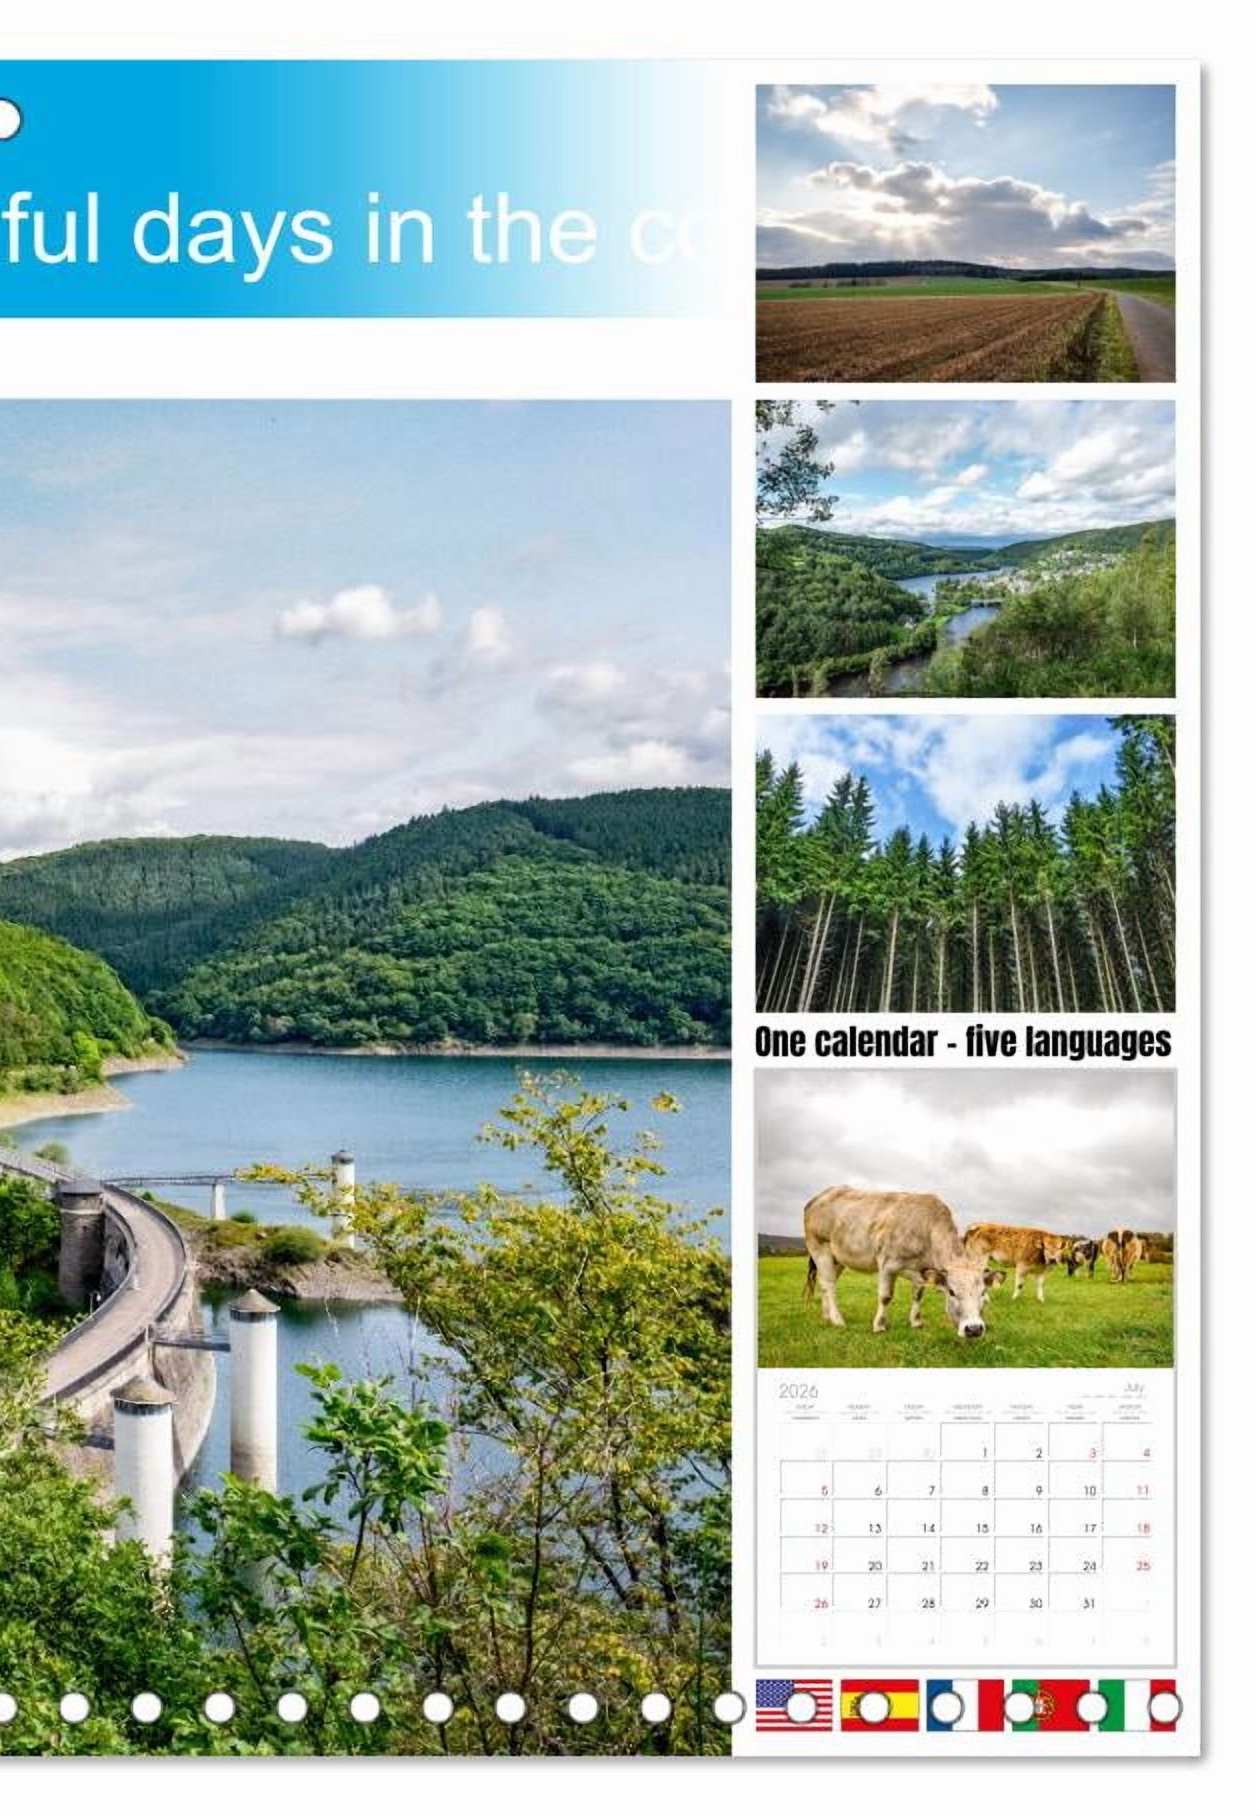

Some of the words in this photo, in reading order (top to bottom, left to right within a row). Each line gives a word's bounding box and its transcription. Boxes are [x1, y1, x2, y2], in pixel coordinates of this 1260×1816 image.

[133, 191, 334, 283] days
[367, 191, 433, 264] in
[467, 191, 597, 265] the
[755, 1025, 806, 1058] One
[815, 1025, 939, 1058] calendar
[966, 1024, 1017, 1058] five
[1026, 1025, 1172, 1062] languages
[779, 1382, 819, 1399] 2026
[1124, 1383, 1145, 1395] July
[983, 1448, 987, 1457] 1
[1036, 1448, 1043, 1459] 2
[874, 1485, 883, 1497] 6
[929, 1485, 936, 1496] 7
[982, 1485, 989, 1496] 8
[1035, 1485, 1043, 1496] 9
[1084, 1485, 1097, 1496] 10
[869, 1523, 882, 1534] 13
[923, 1523, 935, 1533] 14
[977, 1523, 989, 1534] 15
[1030, 1523, 1043, 1534] 16
[1085, 1523, 1097, 1533] 17
[868, 1561, 883, 1572] 20
[922, 1561, 934, 1571] 21
[975, 1561, 989, 1572] 22
[1029, 1561, 1043, 1571] 23
[1083, 1560, 1097, 1571] 24
[868, 1597, 881, 1609] 27
[921, 1598, 936, 1609] 28
[975, 1598, 990, 1609] 29
[1029, 1598, 1043, 1609] 30
[1083, 1598, 1095, 1609] 31
